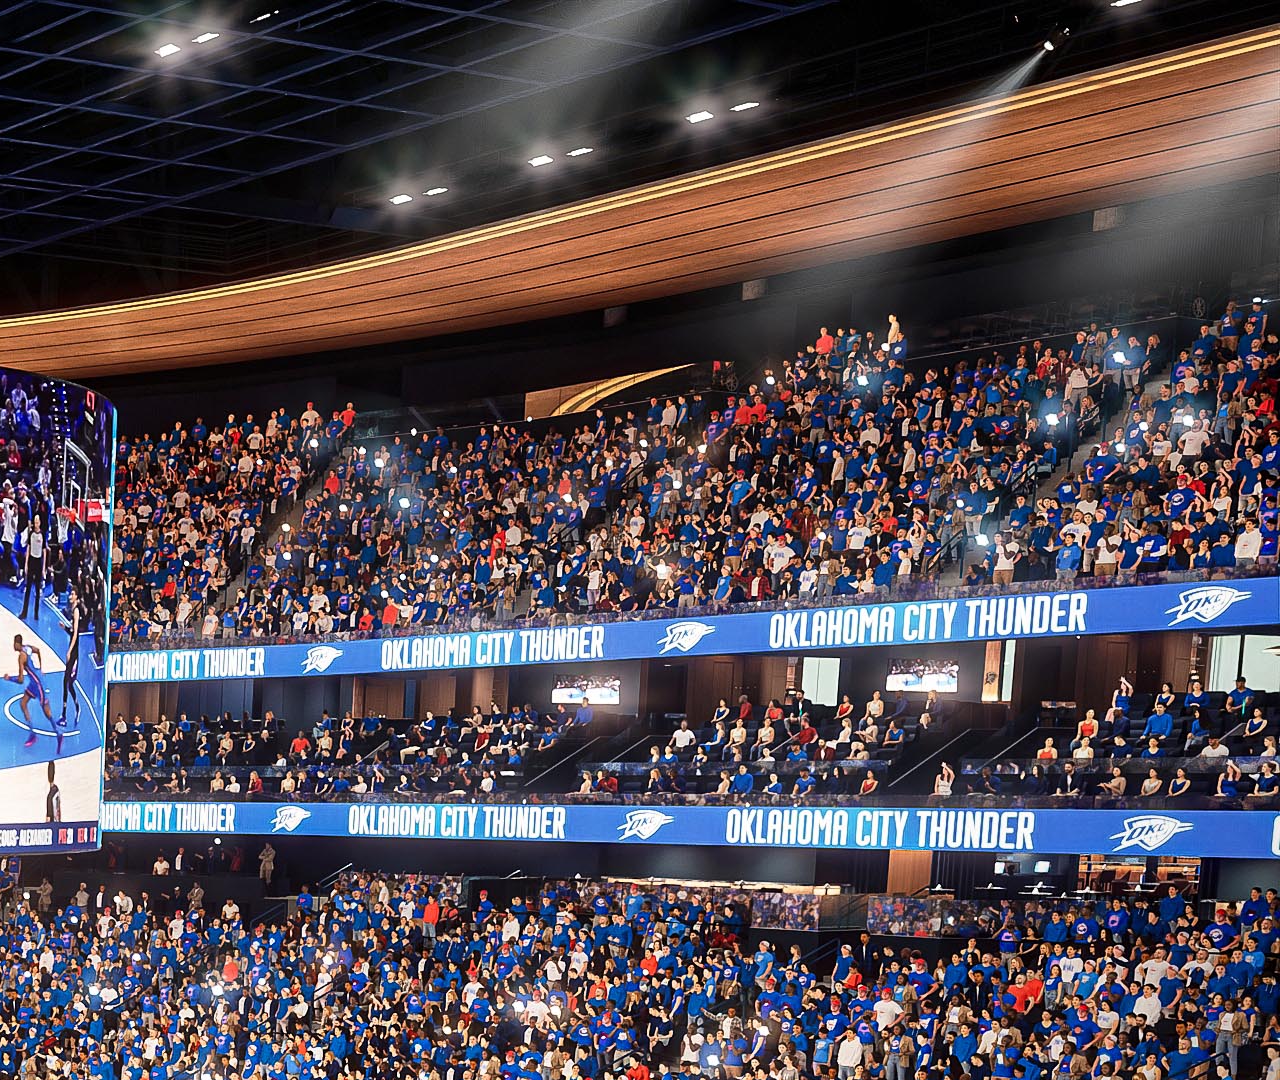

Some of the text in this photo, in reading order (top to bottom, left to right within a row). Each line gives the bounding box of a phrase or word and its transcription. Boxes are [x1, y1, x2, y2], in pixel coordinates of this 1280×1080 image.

[768, 592, 1088, 649] OKLAHOMA CITY THUNDER
[108, 647, 265, 681] KLAHOMA CITY THUNDER
[381, 626, 605, 670] OKLAHOMA CITY THUNDER
[144, 803, 173, 832] CITY
[174, 803, 236, 832] THUNDER
[348, 805, 566, 841] OKLAHOMA CITY THUNDER
[725, 808, 1035, 851] OKLAHOMA CITY THUNDER
